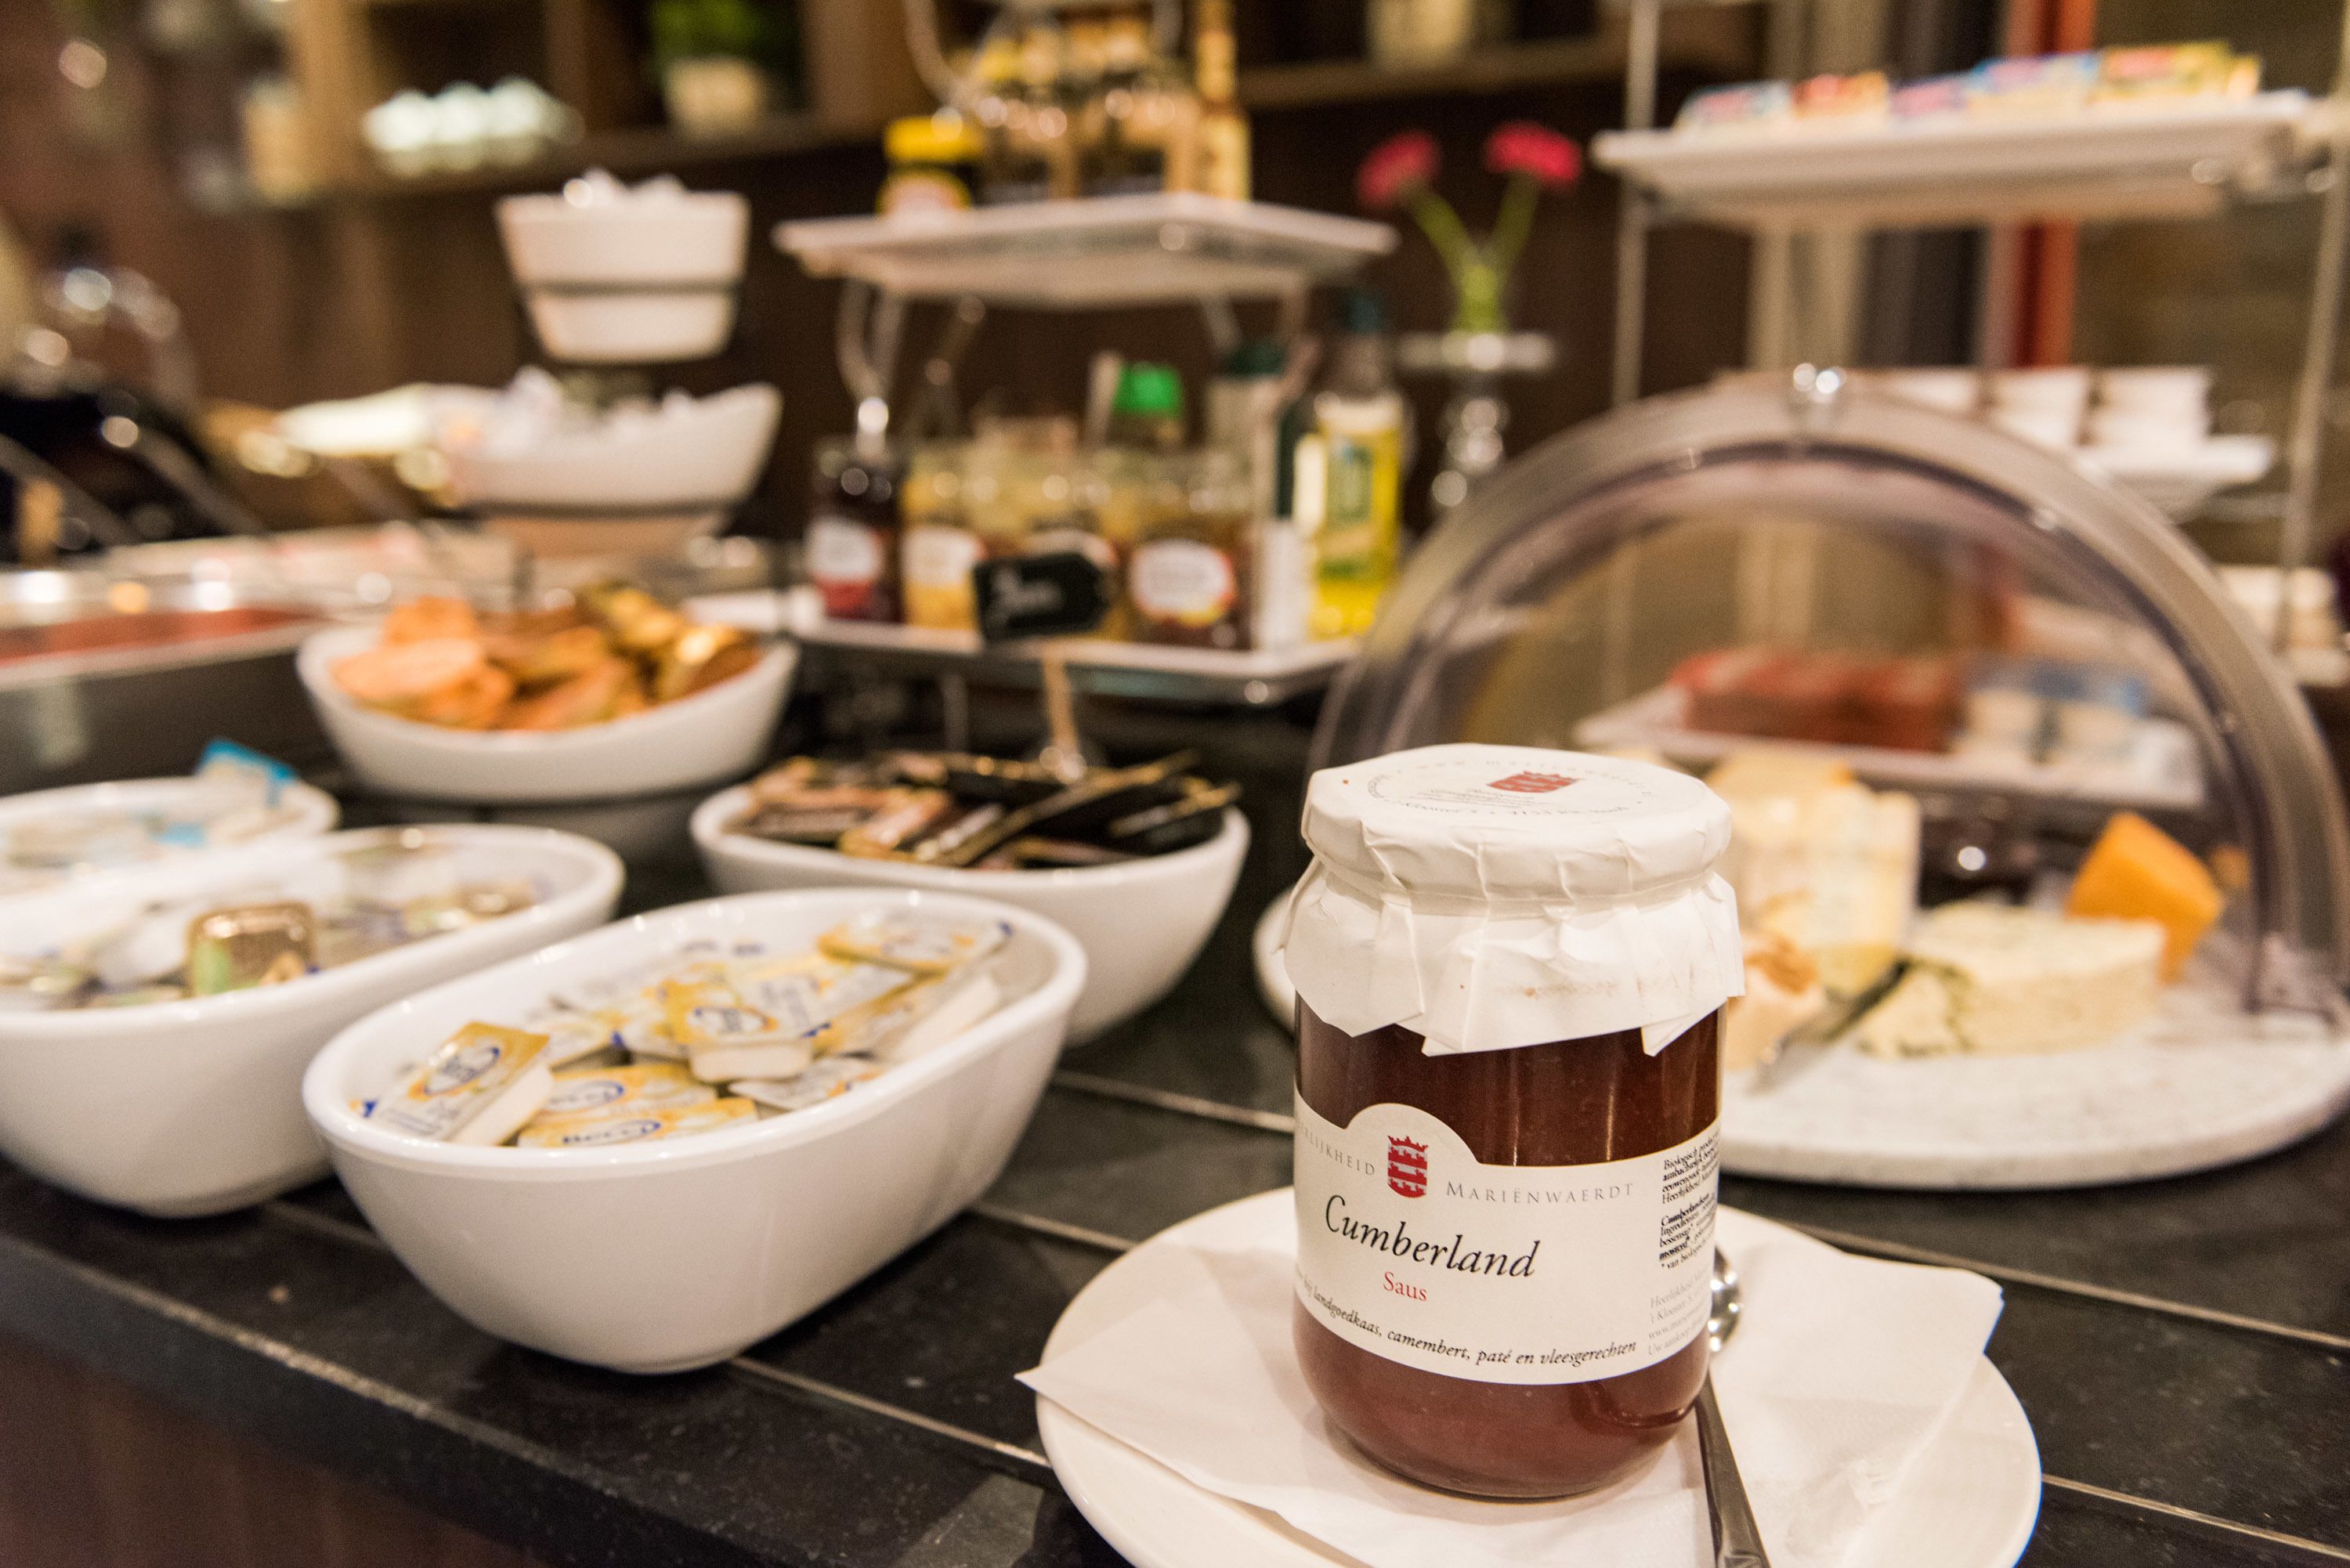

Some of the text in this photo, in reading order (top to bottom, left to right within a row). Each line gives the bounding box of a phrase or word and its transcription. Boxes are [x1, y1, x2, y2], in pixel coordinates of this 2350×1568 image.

[1325, 1194, 1541, 1277] Cumberland
[1383, 1270, 1427, 1302] Saus
[1387, 1329, 1470, 1361] camembert,
[1475, 1349, 1512, 1366] paté
[1516, 1353, 1534, 1365] en
[1539, 1340, 1637, 1368] vleesgerechten
